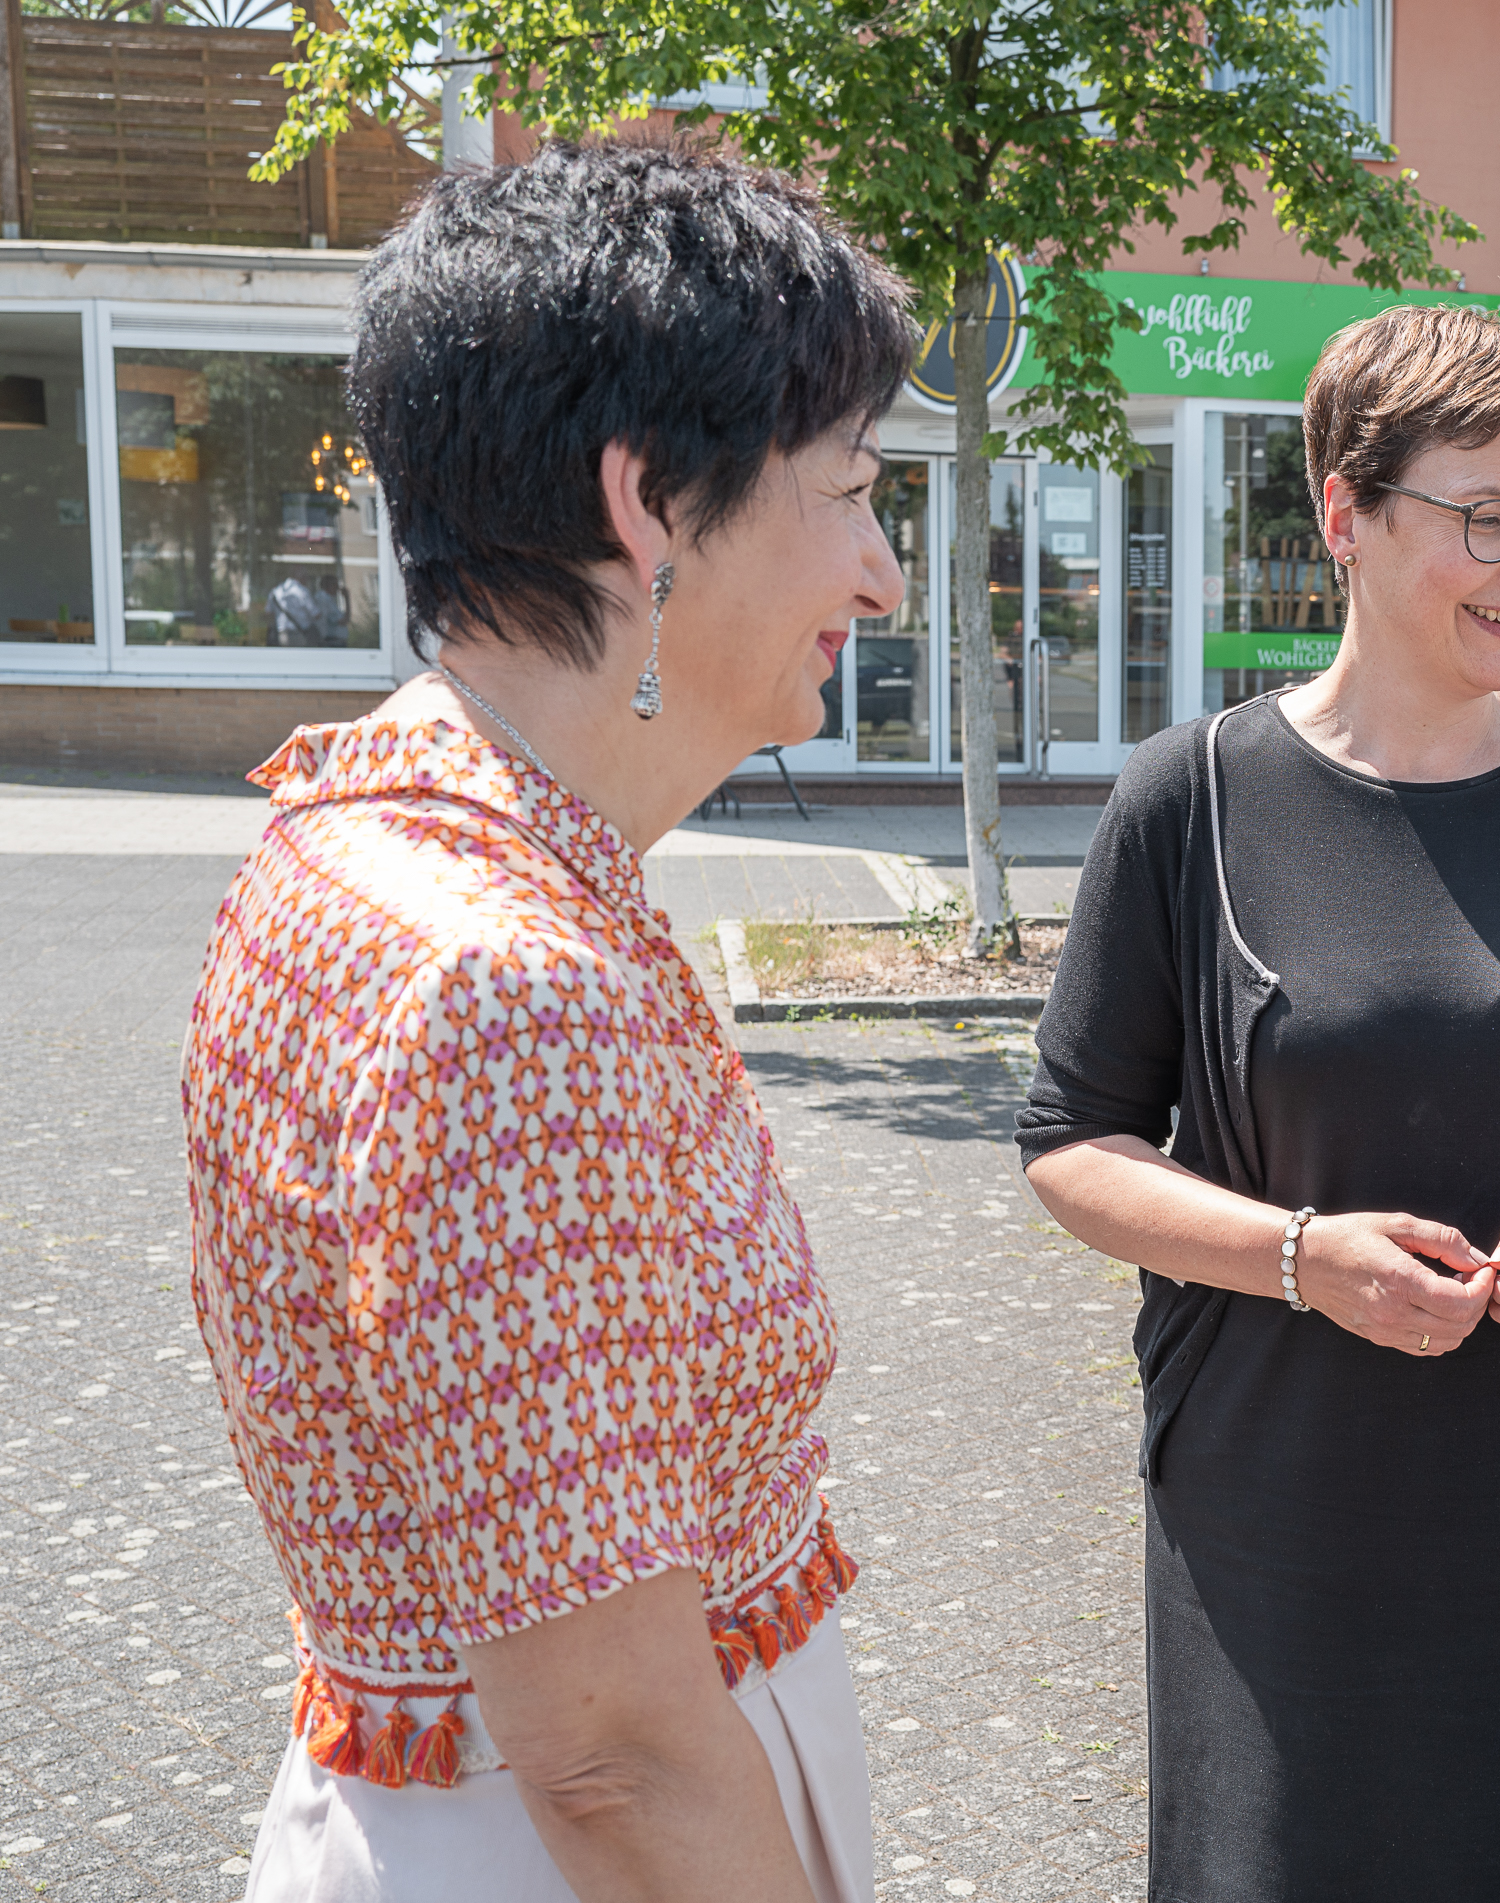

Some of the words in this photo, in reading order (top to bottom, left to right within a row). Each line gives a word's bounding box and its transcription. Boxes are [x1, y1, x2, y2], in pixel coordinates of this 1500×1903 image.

[1163, 334, 1275, 380] Bäckerei
[1292, 638, 1341, 653] BÄCKER
[1257, 648, 1337, 668] WOHLGEM
